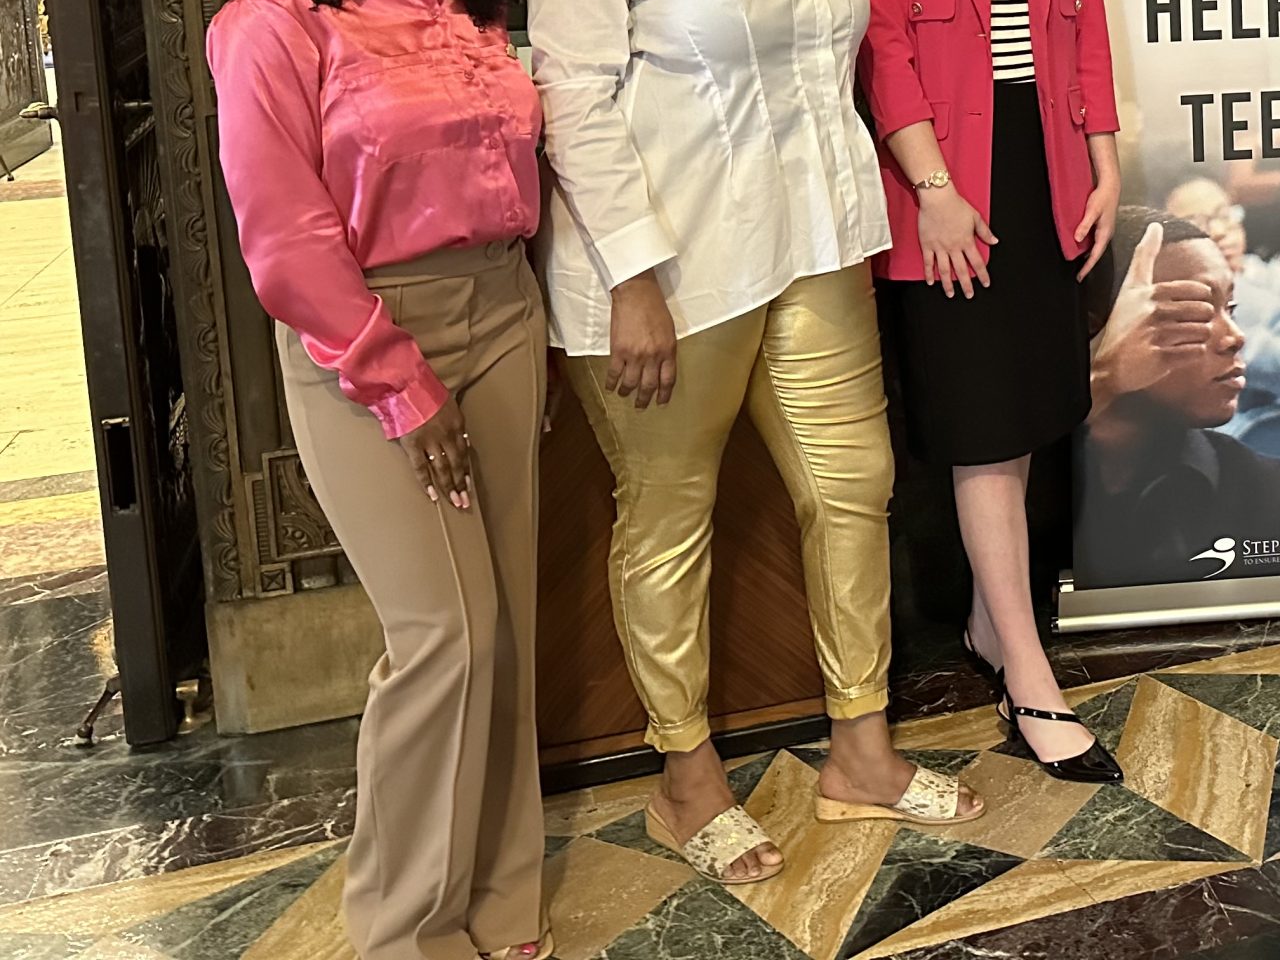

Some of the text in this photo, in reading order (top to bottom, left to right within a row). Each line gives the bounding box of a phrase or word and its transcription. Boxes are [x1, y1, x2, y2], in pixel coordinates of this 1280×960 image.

[1242, 539, 1280, 555] STEP
[1243, 558, 1254, 566] TO
[1255, 557, 1280, 565] ENSURE
